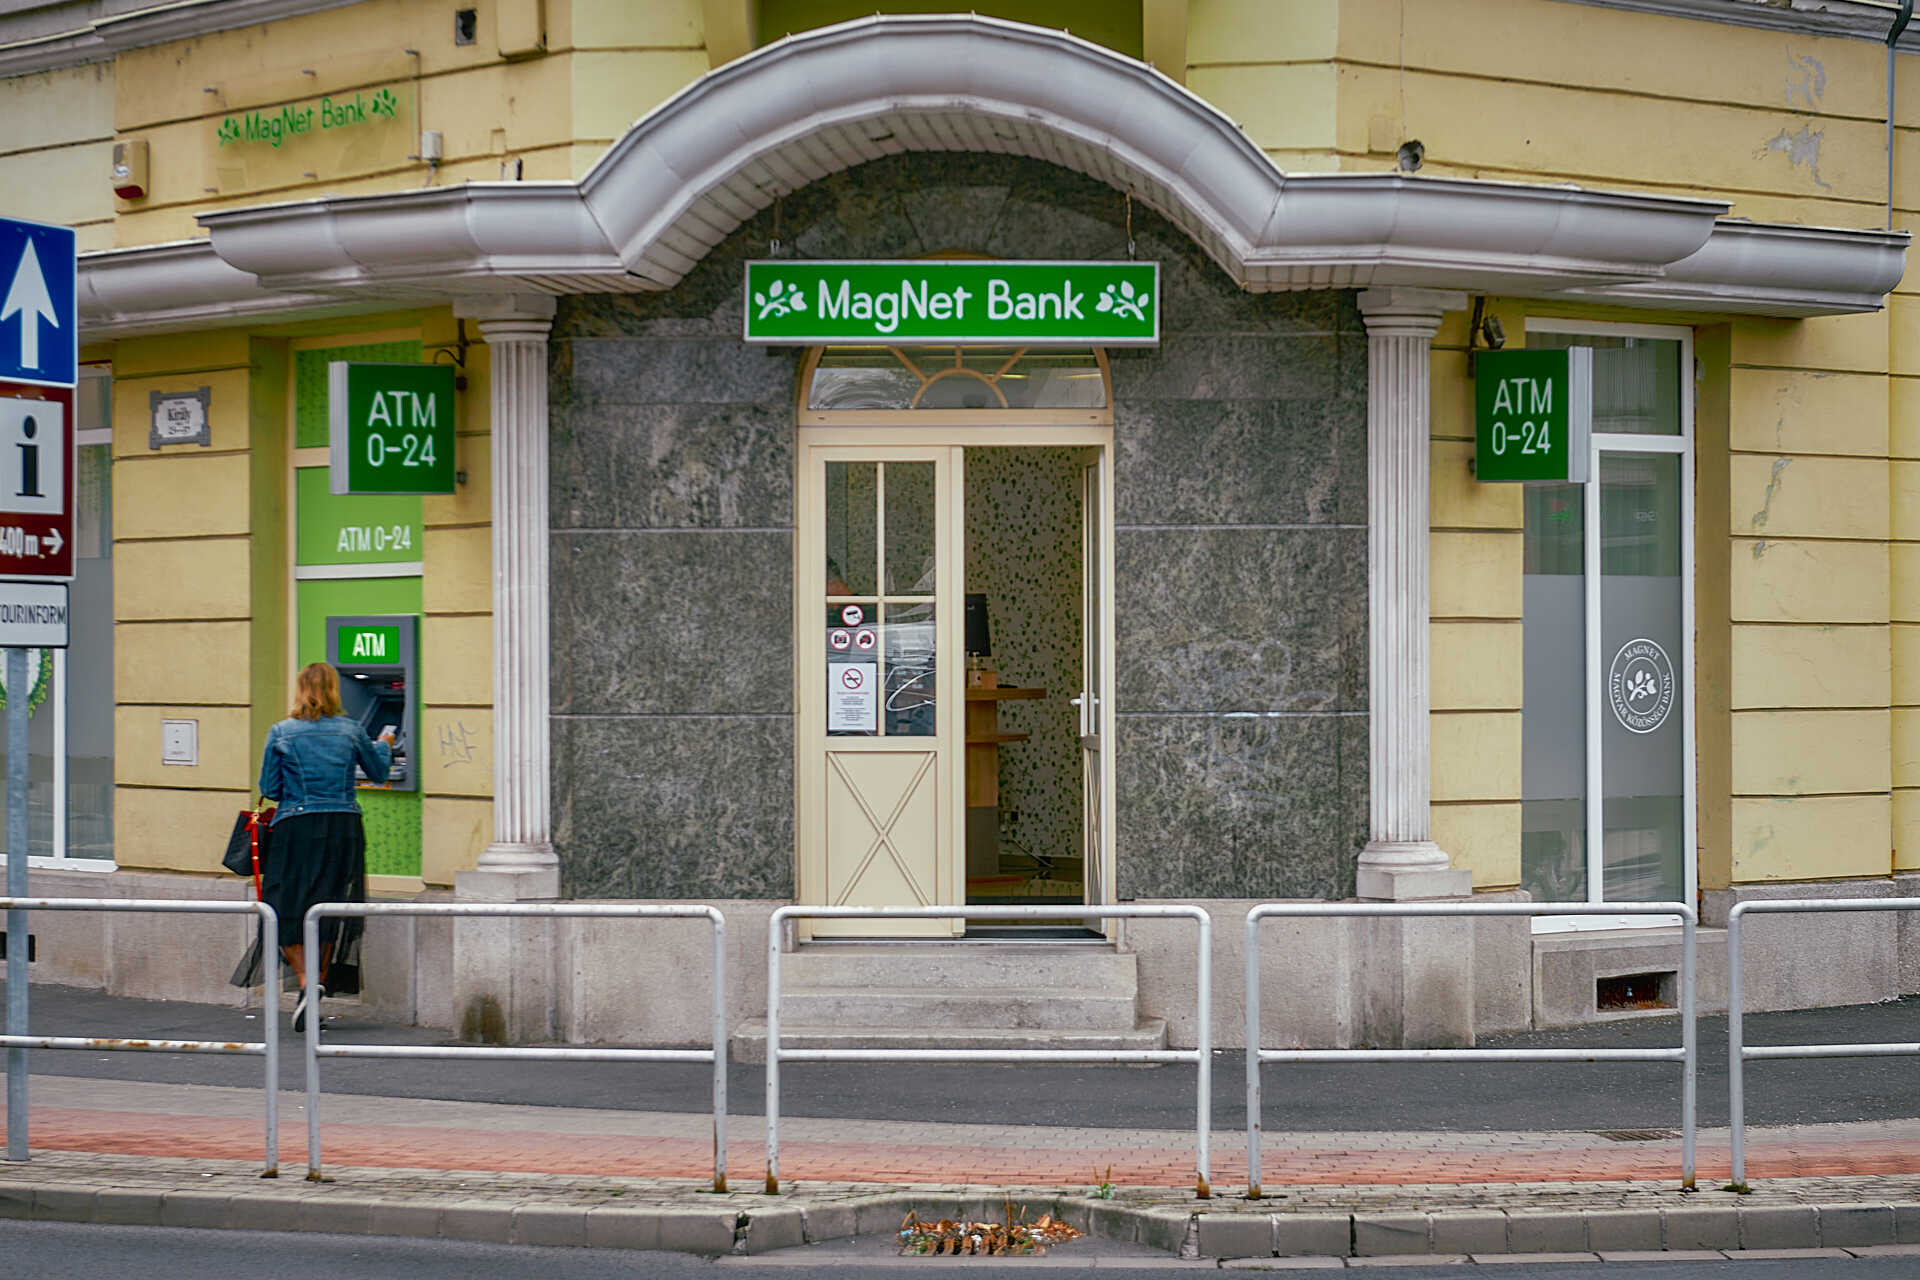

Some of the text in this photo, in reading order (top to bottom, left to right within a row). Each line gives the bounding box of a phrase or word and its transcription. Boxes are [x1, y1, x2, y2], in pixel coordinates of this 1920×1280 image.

[245, 92, 367, 147] MagNet Bank
[818, 278, 1085, 333] MagNet Bank
[367, 390, 437, 428] ATM
[1492, 377, 1553, 416] ATM
[367, 433, 437, 467] 0-24
[1492, 421, 1552, 456] 0-24
[337, 525, 412, 552] ATM 0-24
[0, 604, 66, 625] OURINFORM
[352, 632, 386, 657] ATM
[1624, 645, 1661, 660] MAGNET
[1662, 672, 1672, 704] BANK
